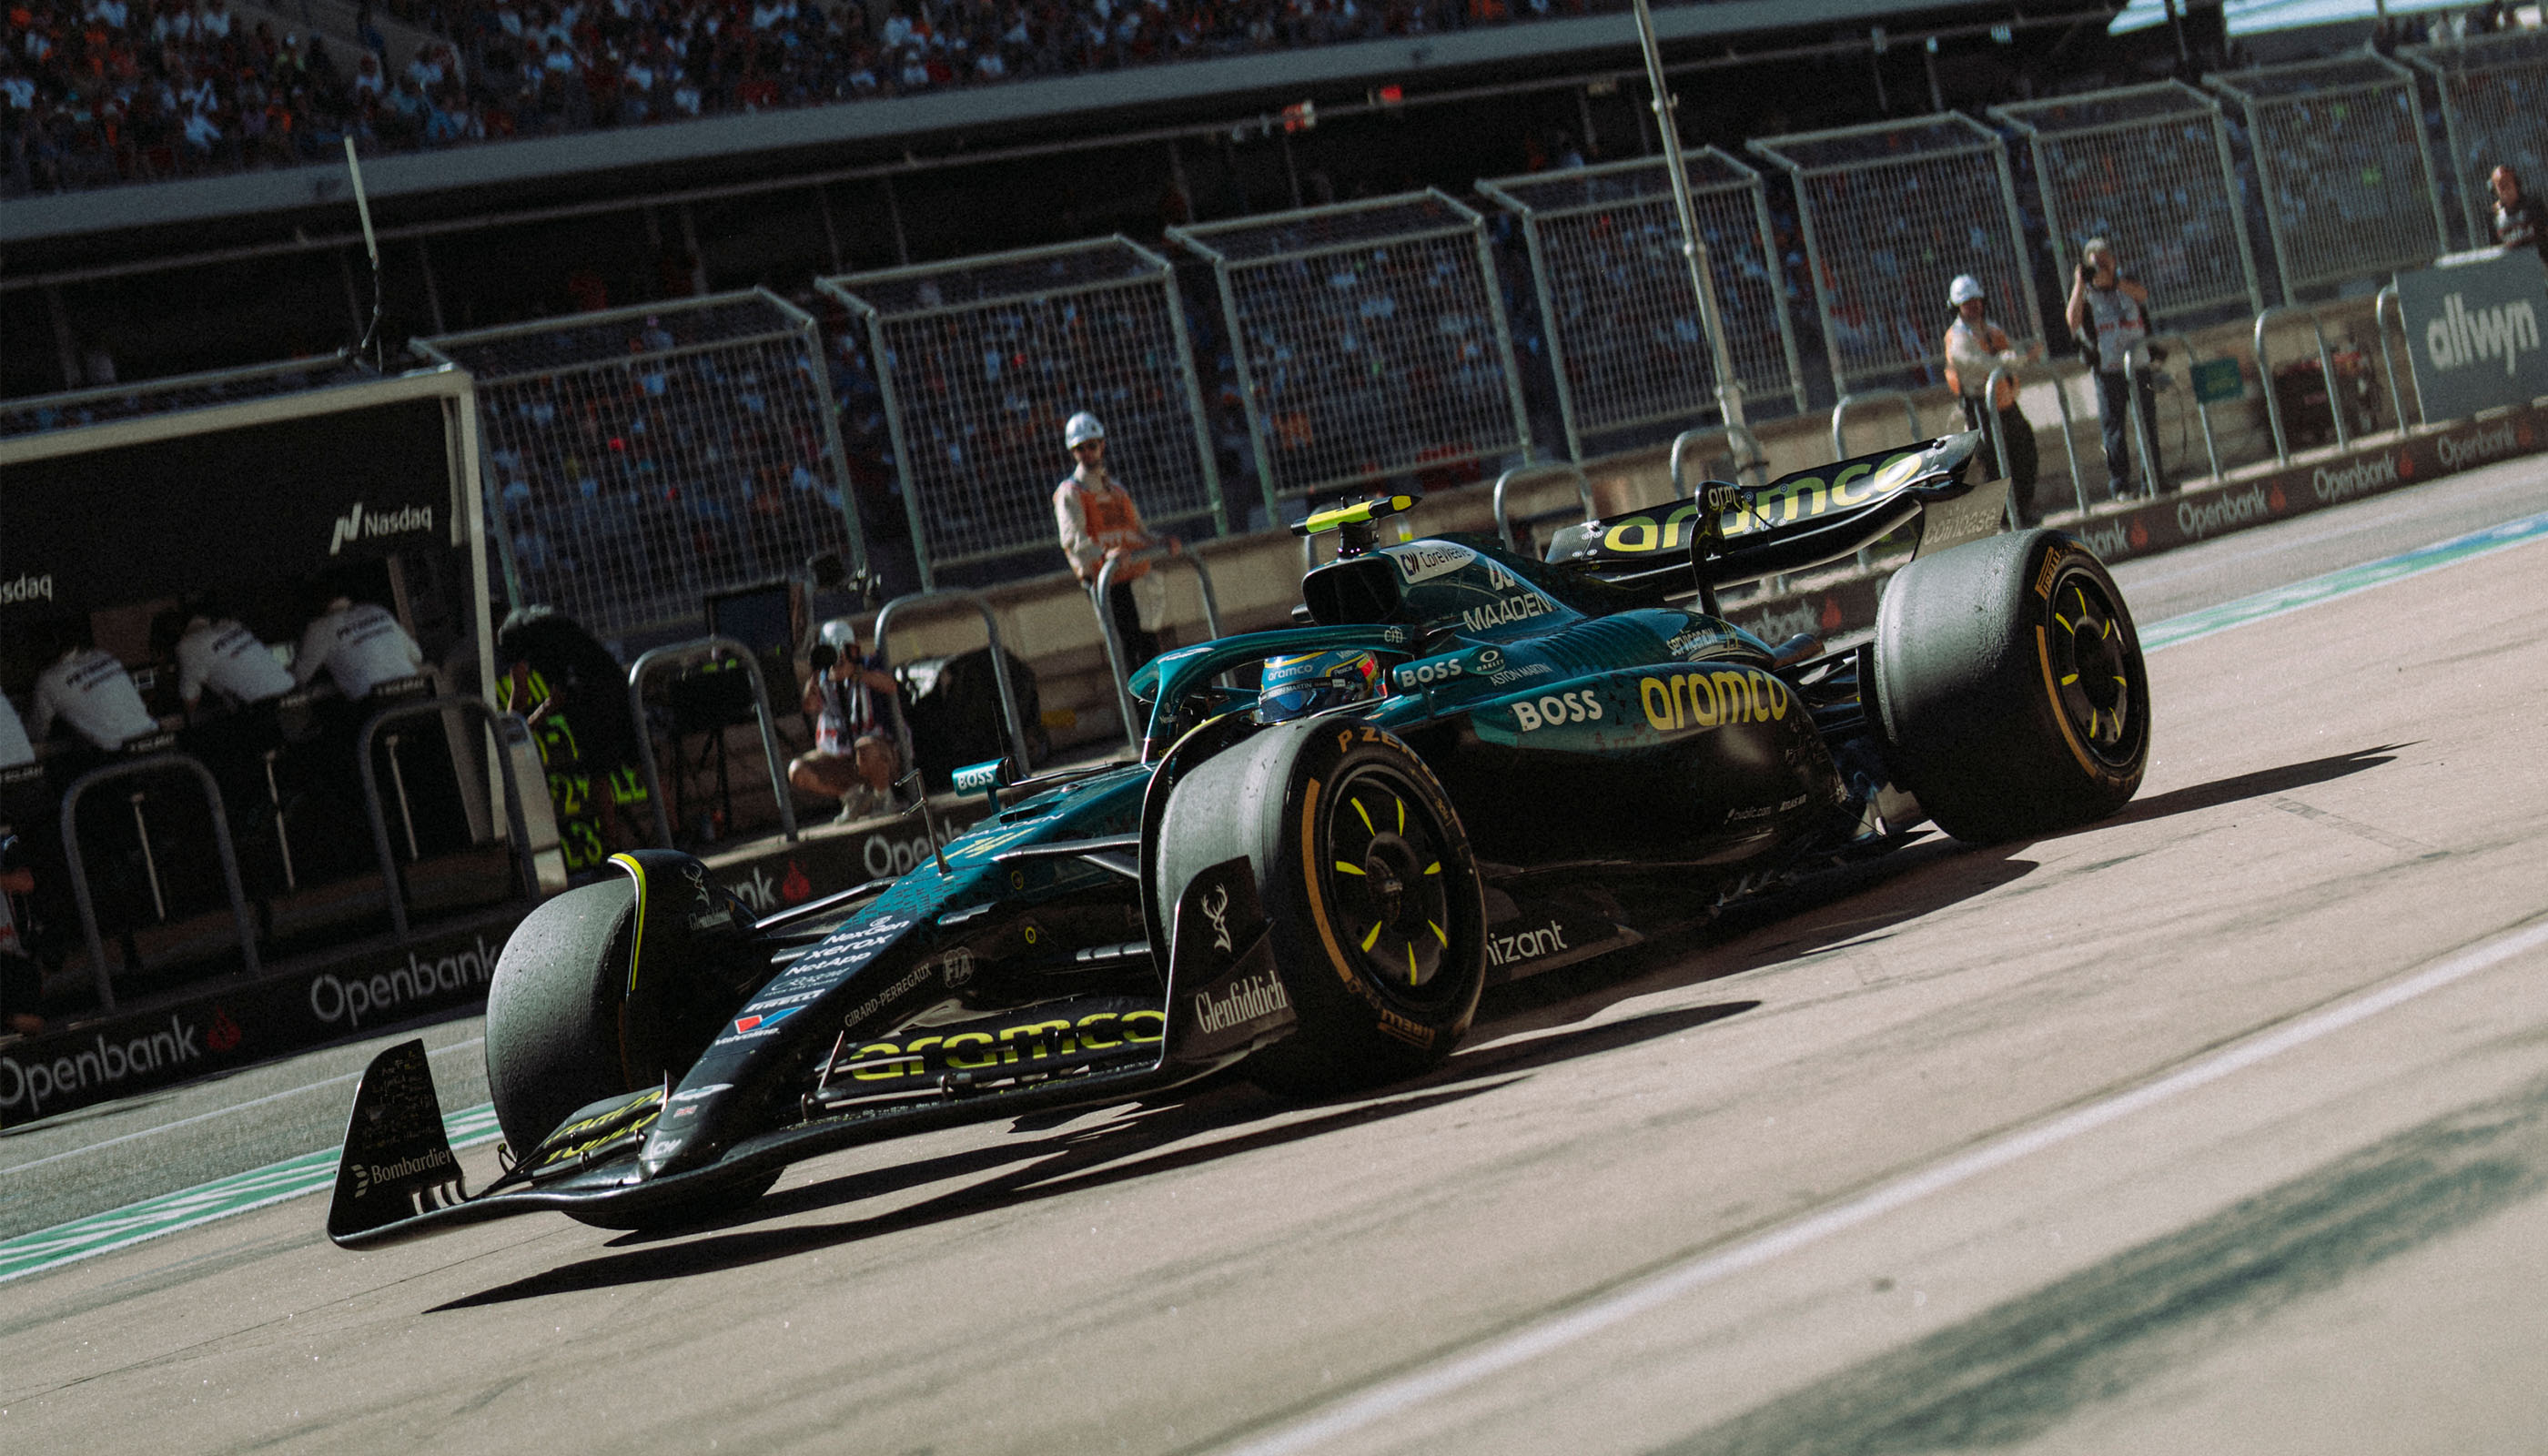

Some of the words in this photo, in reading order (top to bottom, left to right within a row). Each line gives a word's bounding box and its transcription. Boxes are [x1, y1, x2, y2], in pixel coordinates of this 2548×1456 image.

[2426, 292, 2539, 376] allwyn
[2437, 421, 2518, 468] Openbank
[2314, 454, 2400, 504] Openbank
[365, 504, 432, 539] Nasdaq
[2178, 485, 2268, 539] Openbank
[2083, 518, 2130, 554] bank
[1463, 592, 1552, 632] MAADEN
[1268, 664, 1313, 682] aramco
[1400, 659, 1461, 688] BOSS
[1490, 671, 1521, 687] ASTON
[1522, 662, 1552, 679] MARTIN
[1512, 690, 1603, 732] BOSS
[1641, 671, 1787, 730] aramco
[1338, 729, 1353, 753] P
[957, 770, 995, 791] BOSS
[804, 934, 894, 960] xerox
[824, 920, 909, 945] NexGen
[1485, 919, 1568, 966] nizant
[310, 935, 501, 1027] Openbank
[784, 952, 872, 976] NetApp
[844, 963, 932, 1026] GIRARD-PERREGAUX
[1195, 969, 1287, 1035] Glenfiddich
[0, 1015, 201, 1116] Openbank
[849, 1010, 1166, 1081] aramco
[371, 1148, 451, 1185] Bombardier
